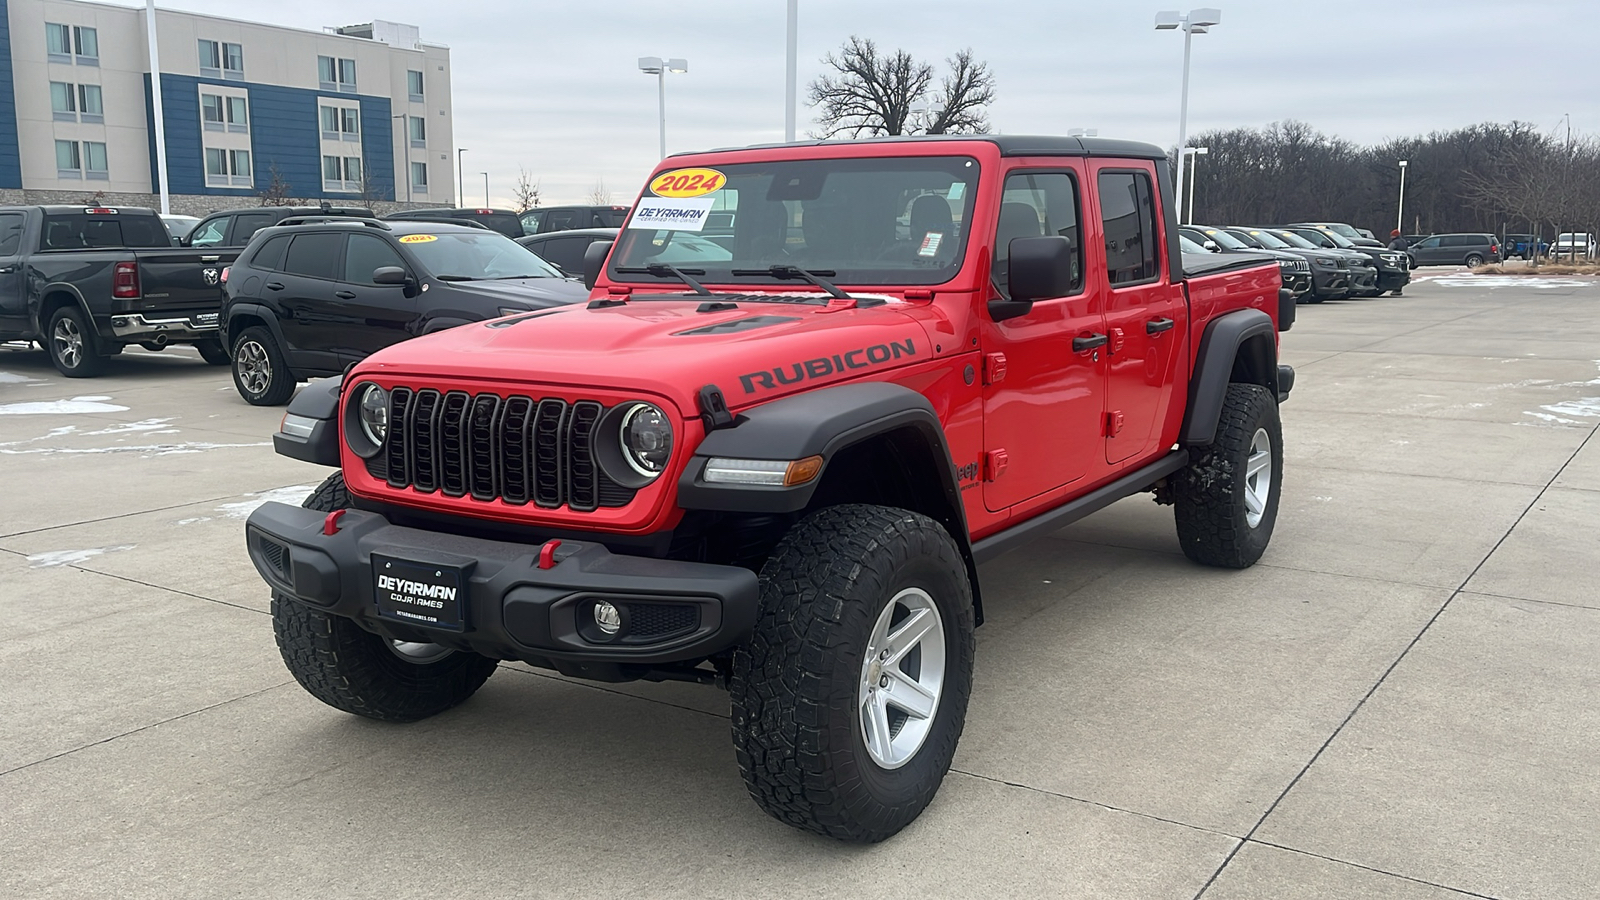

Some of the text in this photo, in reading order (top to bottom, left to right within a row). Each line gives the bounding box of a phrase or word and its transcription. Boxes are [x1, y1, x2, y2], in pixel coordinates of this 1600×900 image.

[656, 175, 720, 191] 2024
[638, 208, 704, 218] DEYARMAN
[739, 338, 916, 394] RUBICON
[378, 574, 457, 601] DEYARMAN
